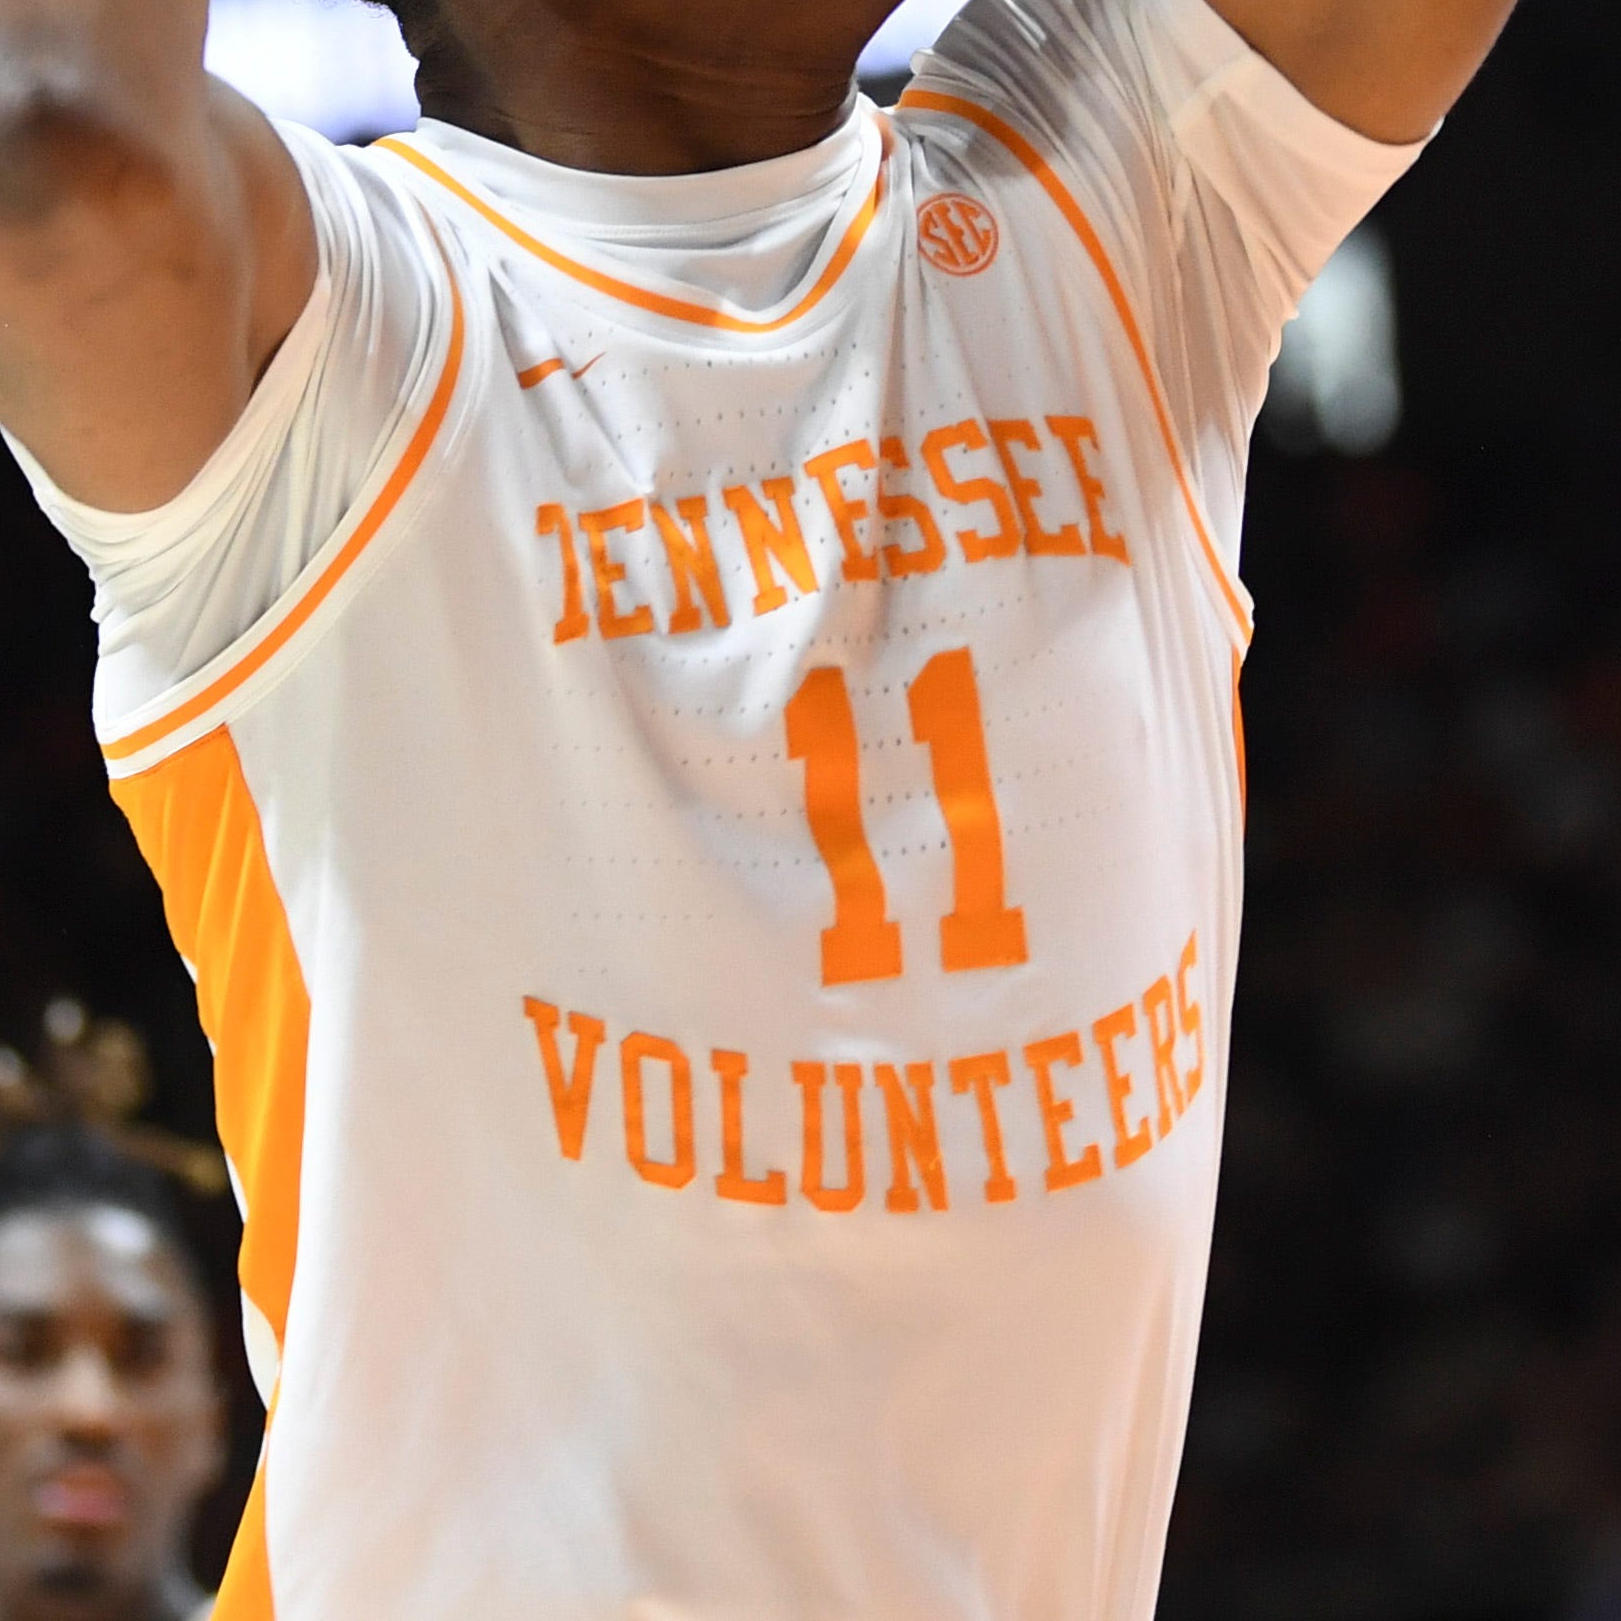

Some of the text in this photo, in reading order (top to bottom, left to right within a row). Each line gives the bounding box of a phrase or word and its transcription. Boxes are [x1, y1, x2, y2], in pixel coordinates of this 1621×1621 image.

[918, 197, 993, 269] SEC
[535, 413, 1135, 647] TENNESSEE
[782, 645, 1031, 989] 11
[521, 929, 1206, 1217] VOLUNTEERS
